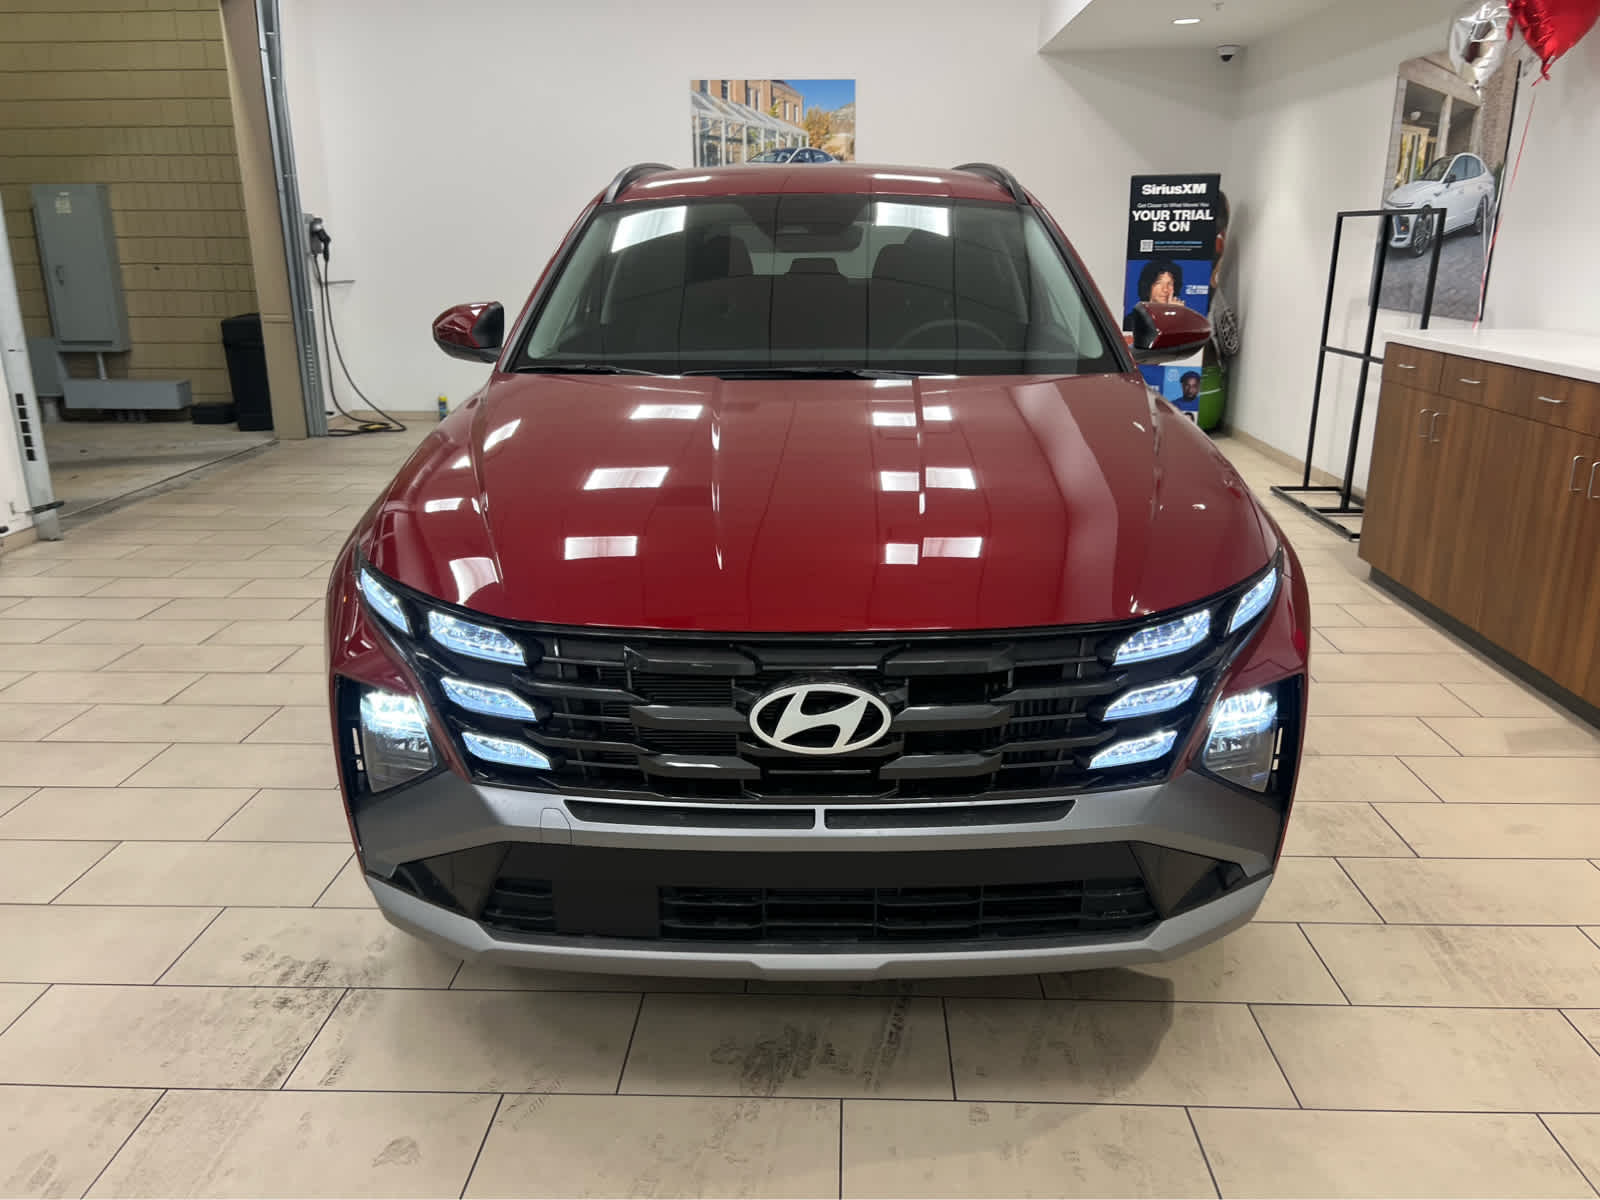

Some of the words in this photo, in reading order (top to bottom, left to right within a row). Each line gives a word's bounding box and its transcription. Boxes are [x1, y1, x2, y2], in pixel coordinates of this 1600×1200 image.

[1141, 183, 1207, 195] SiriusXM
[1132, 210, 1170, 221] YOUR
[1173, 209, 1214, 220] TRIAL
[1152, 221, 1167, 232] IS
[1168, 221, 1190, 232] ON
